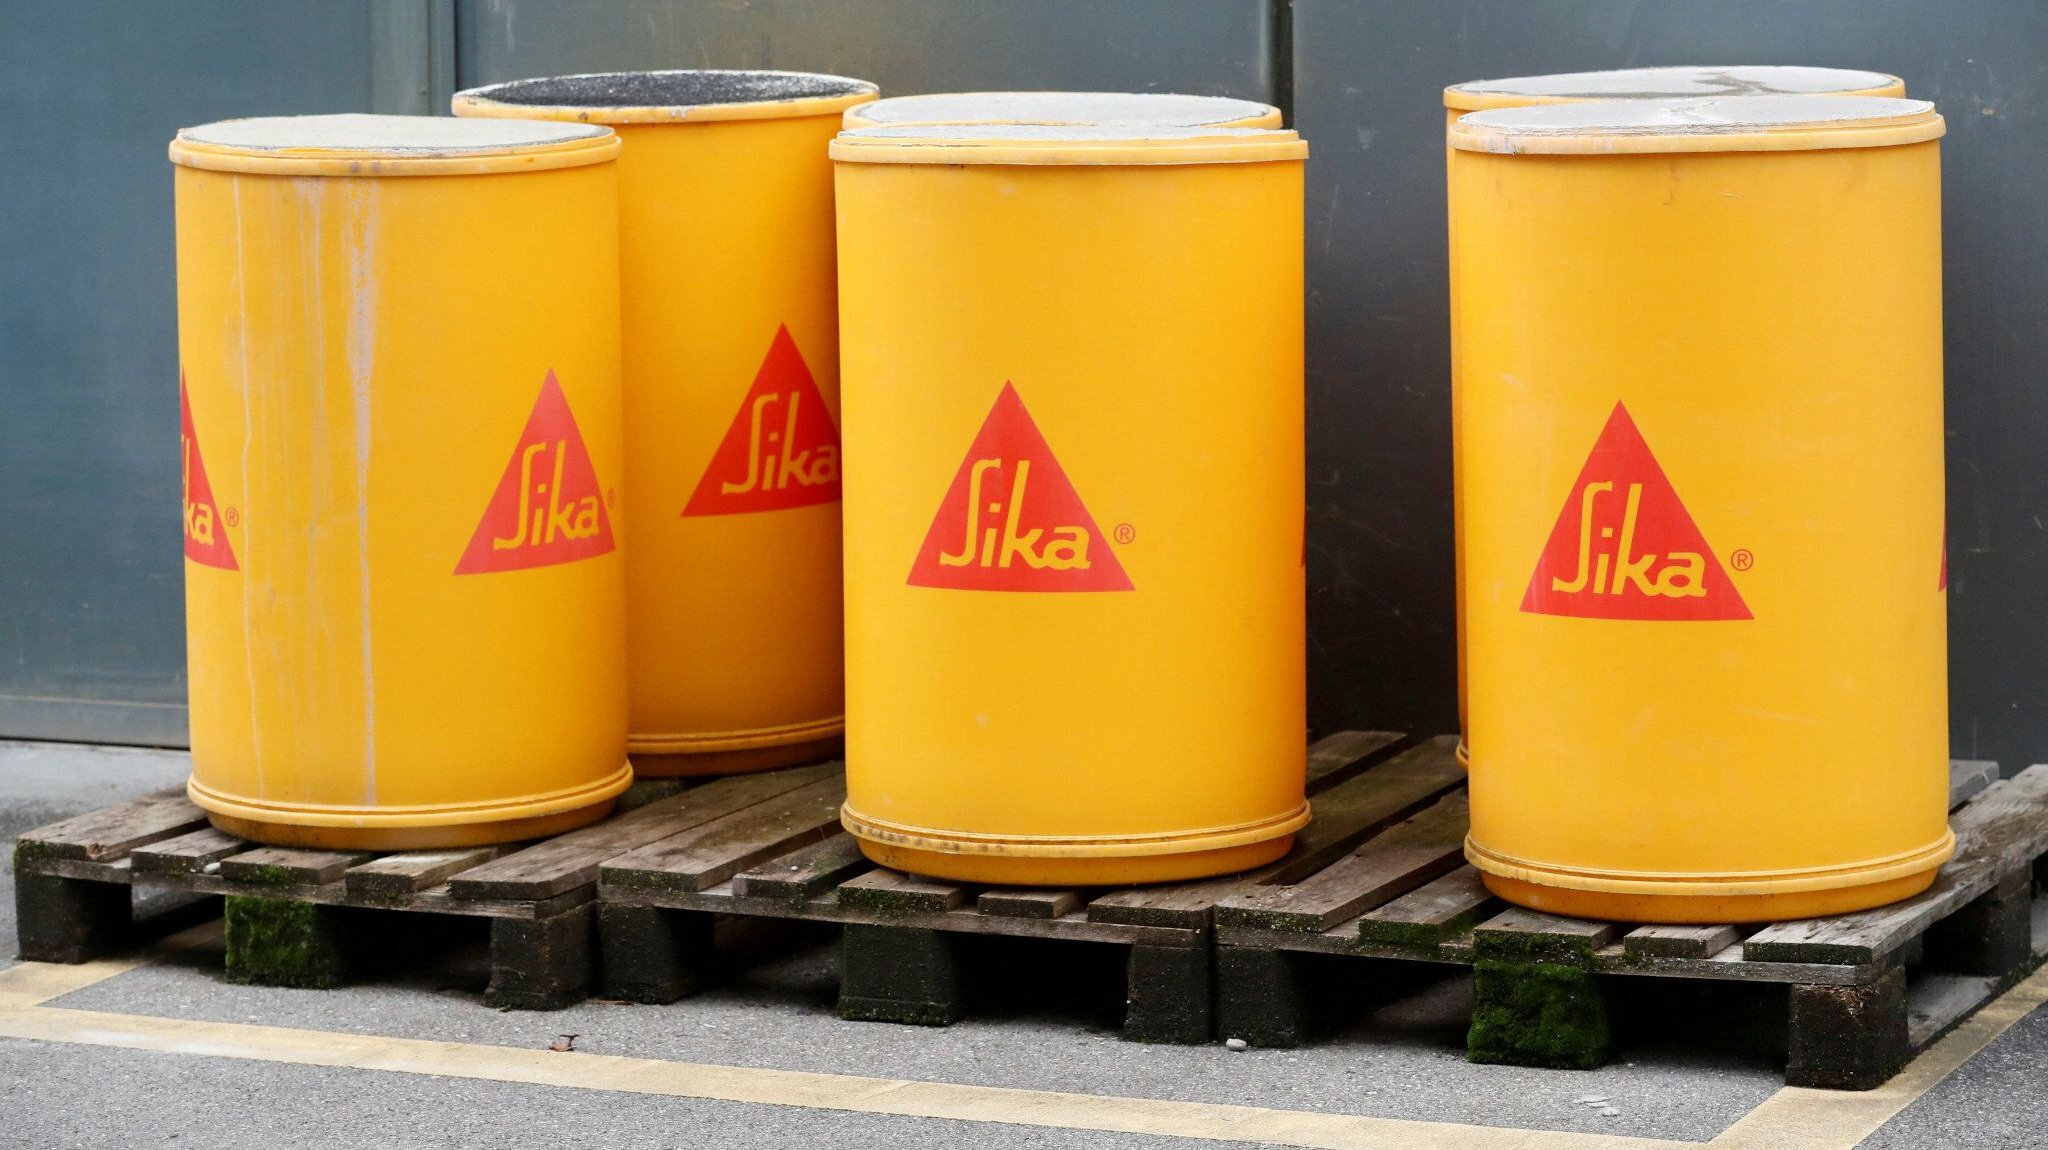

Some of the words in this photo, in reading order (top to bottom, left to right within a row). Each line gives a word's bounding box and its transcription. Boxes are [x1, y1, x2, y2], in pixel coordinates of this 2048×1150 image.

[493, 440, 600, 550] Sika
[721, 391, 839, 494] Sika
[939, 458, 1092, 570] Sika
[1552, 481, 1708, 598] Sika
